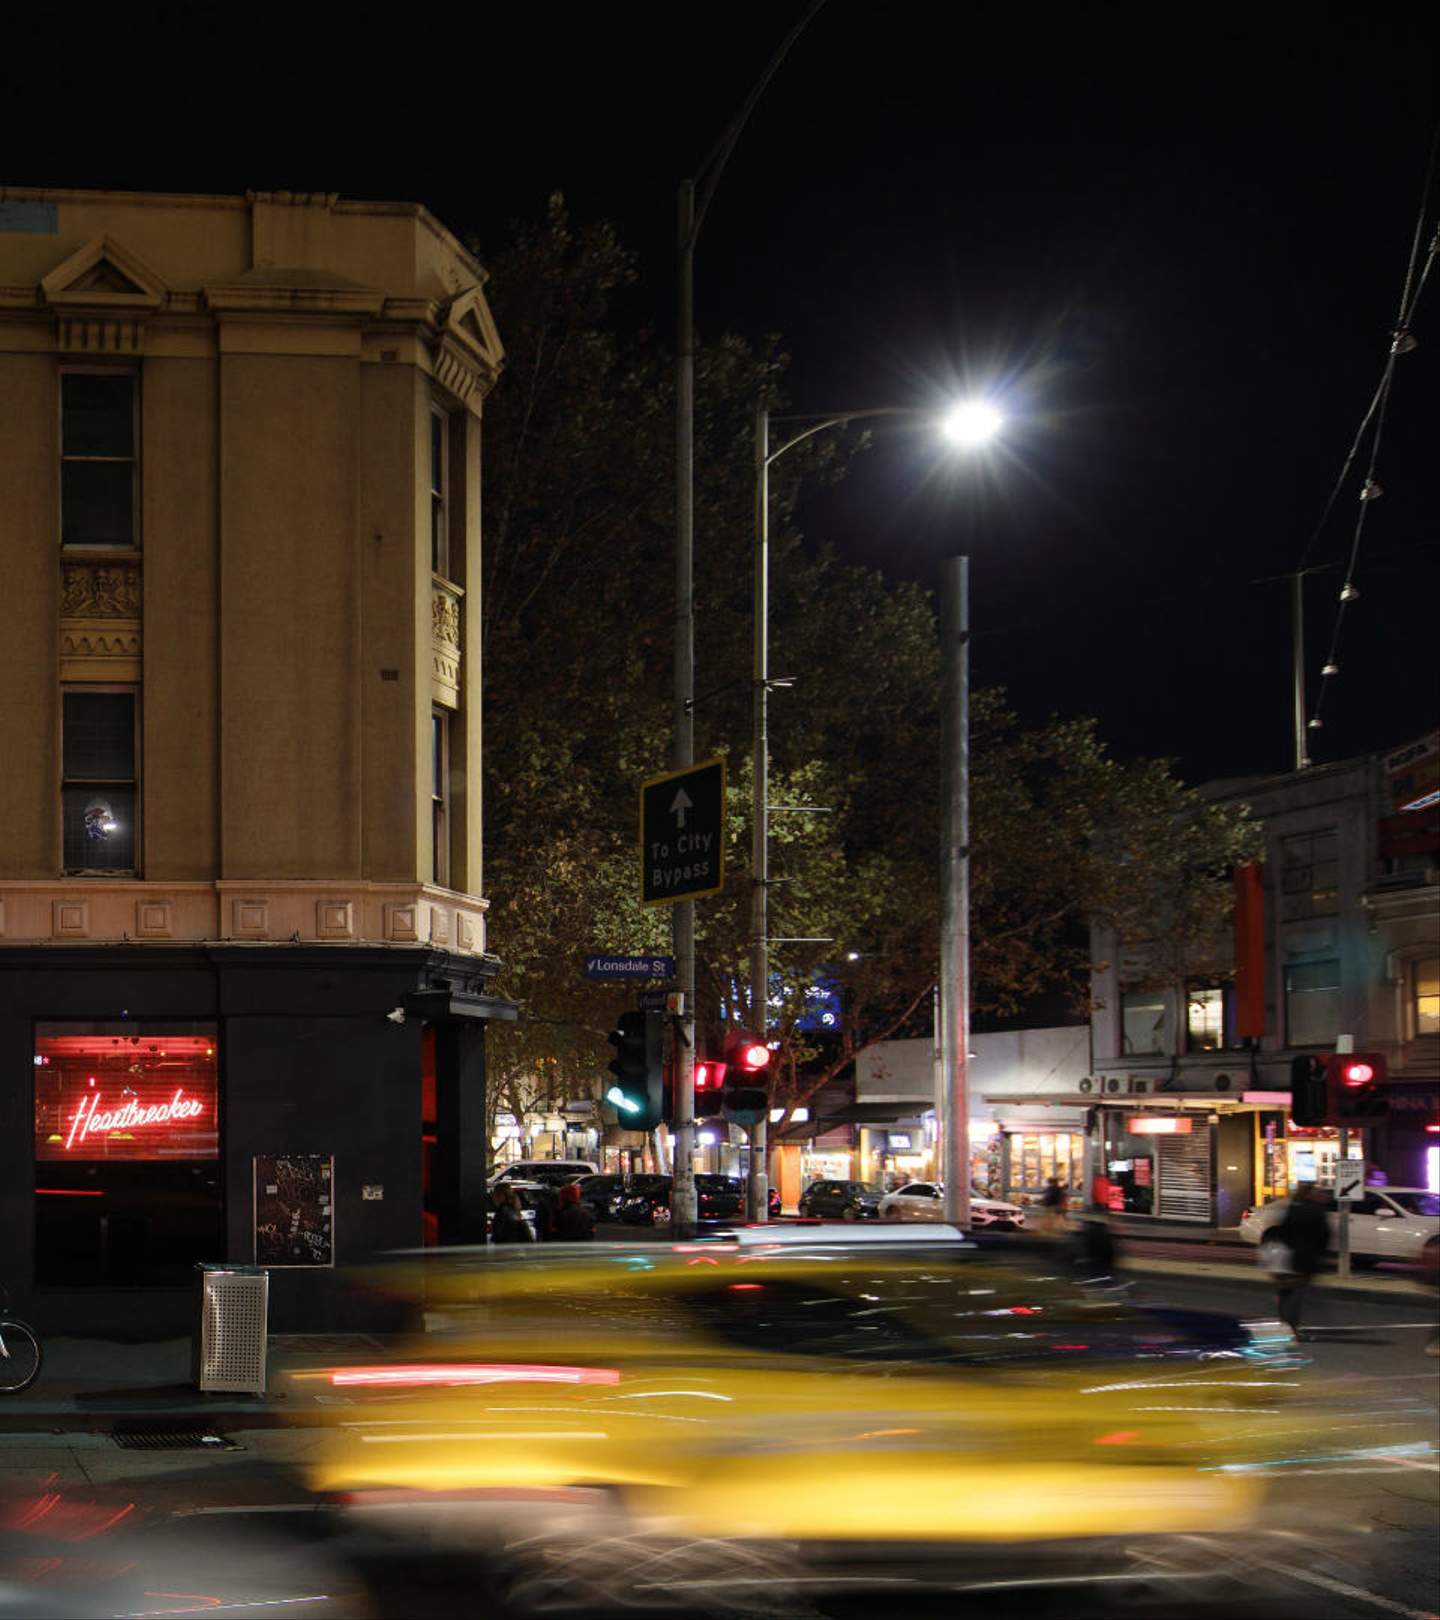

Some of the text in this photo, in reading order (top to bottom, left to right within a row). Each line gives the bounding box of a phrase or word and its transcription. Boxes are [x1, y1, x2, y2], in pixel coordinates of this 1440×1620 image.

[652, 831, 713, 861] To City
[652, 861, 710, 888] Bypass
[597, 959, 667, 973] Lonsdale St
[65, 1088, 203, 1150] Heartbreaker
